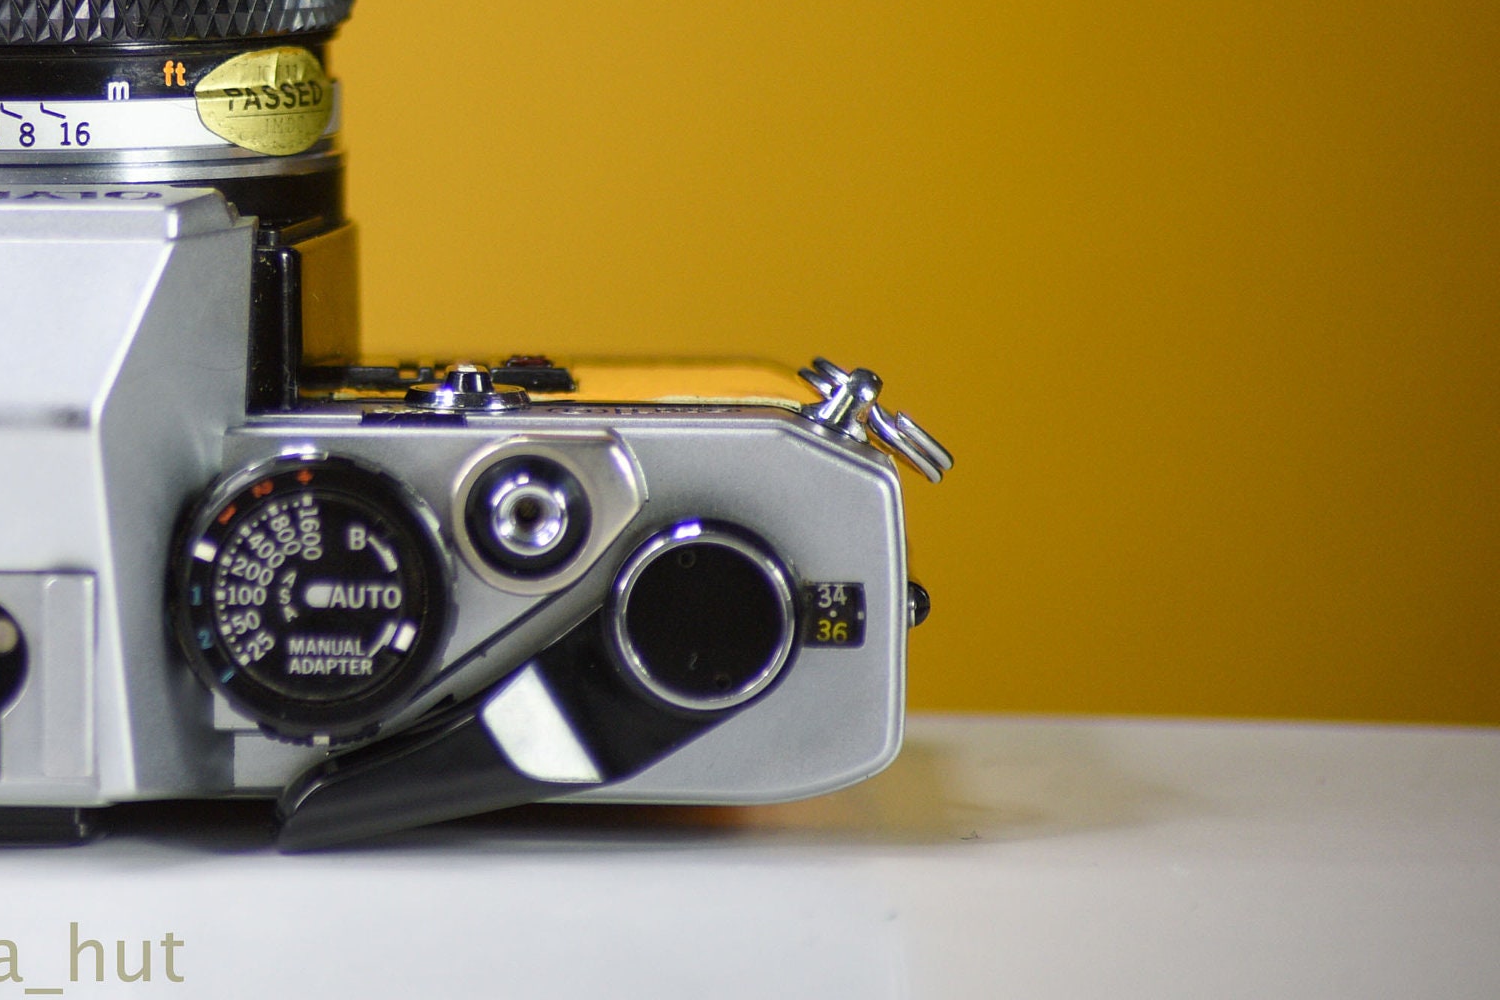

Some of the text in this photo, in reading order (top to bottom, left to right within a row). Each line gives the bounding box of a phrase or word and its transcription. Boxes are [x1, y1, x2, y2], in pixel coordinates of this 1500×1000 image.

[162, 60, 187, 87] ft
[107, 80, 130, 101] m
[223, 80, 323, 112] PASSED
[19, 122, 36, 148] 8
[60, 121, 91, 147] 16
[269, 513, 302, 556] 800
[298, 506, 323, 561] 1600
[348, 526, 366, 551] B
[248, 532, 285, 569] 400
[231, 556, 274, 587] 200
[227, 586, 267, 606] 100
[331, 584, 402, 609] AUTO
[817, 584, 848, 608] 34
[231, 610, 260, 635] 50
[816, 619, 848, 643] 36
[246, 632, 275, 661] 25
[288, 638, 364, 656] MANUAL
[289, 657, 373, 675] ADAPTER
